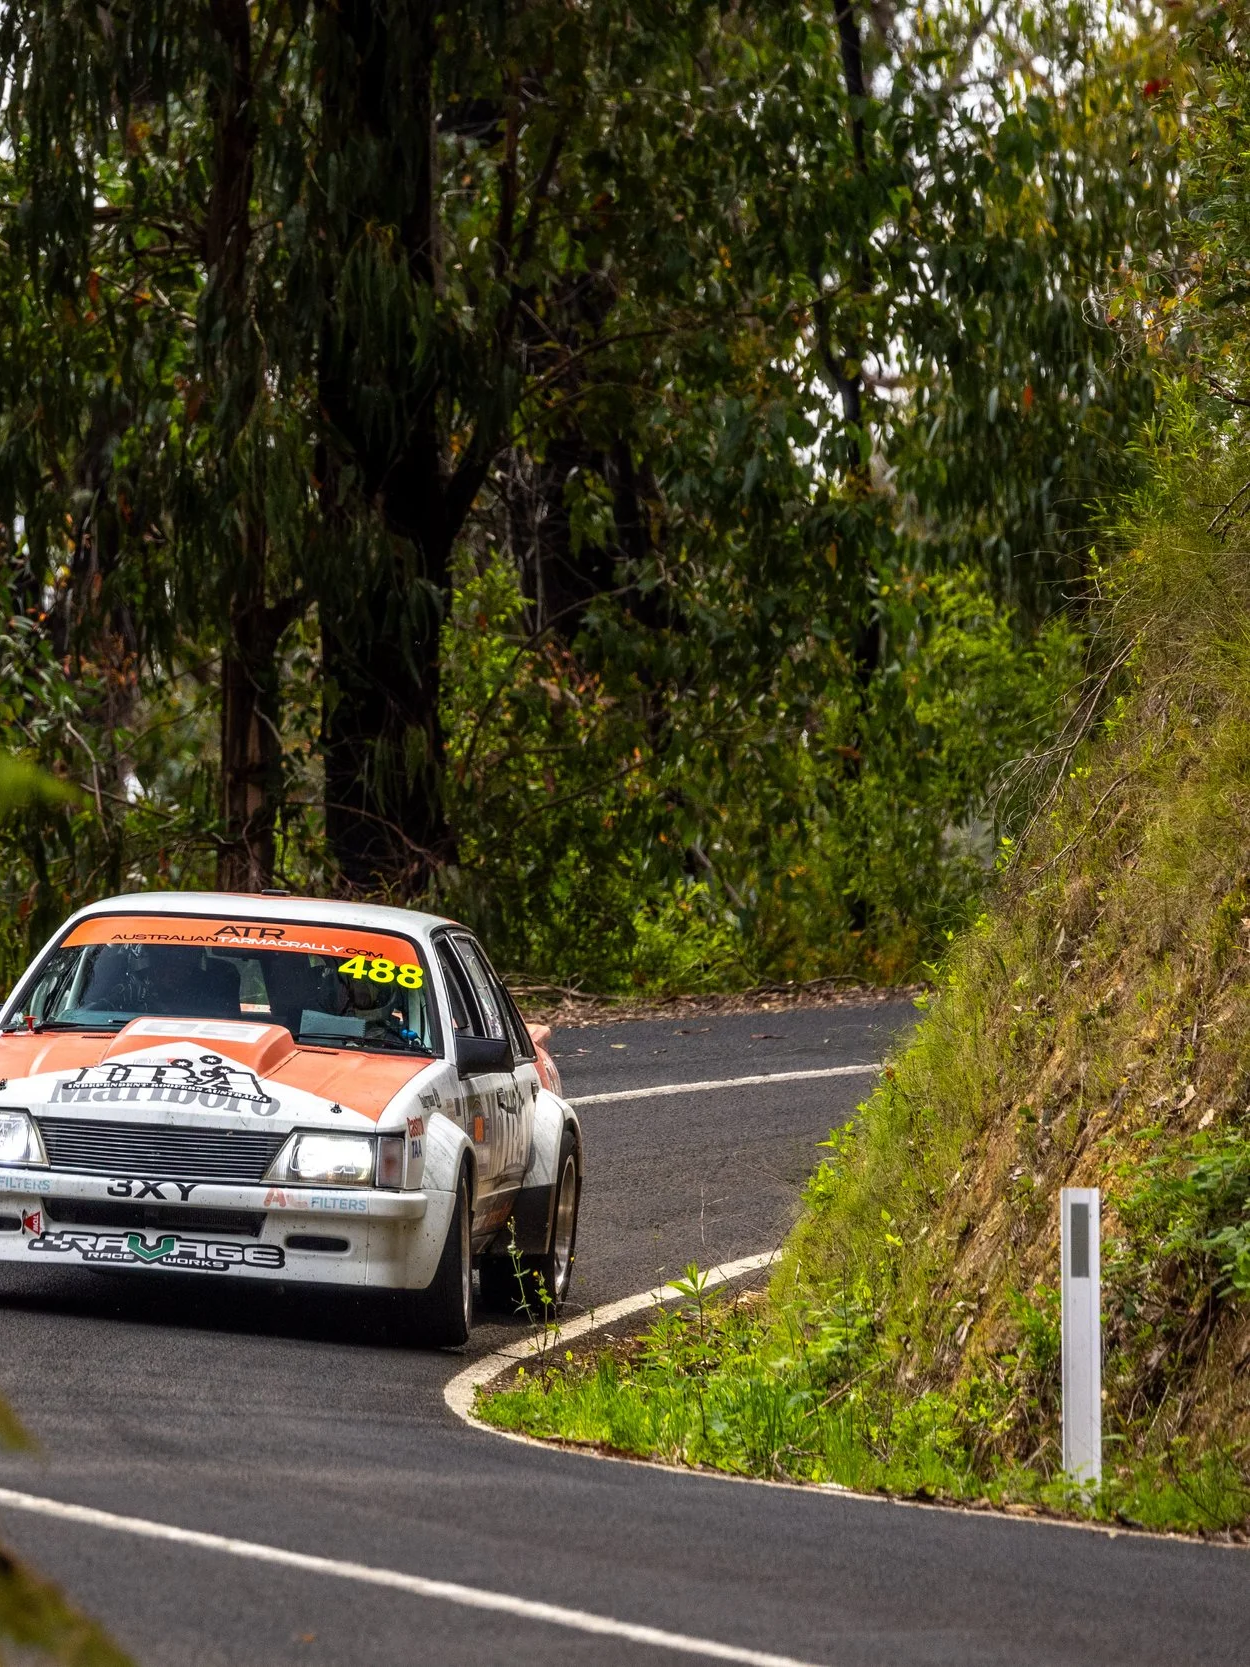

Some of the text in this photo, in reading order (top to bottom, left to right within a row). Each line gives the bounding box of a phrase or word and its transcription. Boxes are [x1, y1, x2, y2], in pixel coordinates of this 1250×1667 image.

[214, 925, 286, 940] ATR
[338, 955, 424, 990] 488
[67, 1081, 150, 1090] INDEPENDENT
[204, 1085, 268, 1103] AUSTRALIA
[107, 1178, 199, 1202] 3XY
[311, 1196, 367, 1211] FILTERS
[60, 1234, 284, 1267] RAVAGE
[87, 1251, 225, 1269] RACE WORKS
